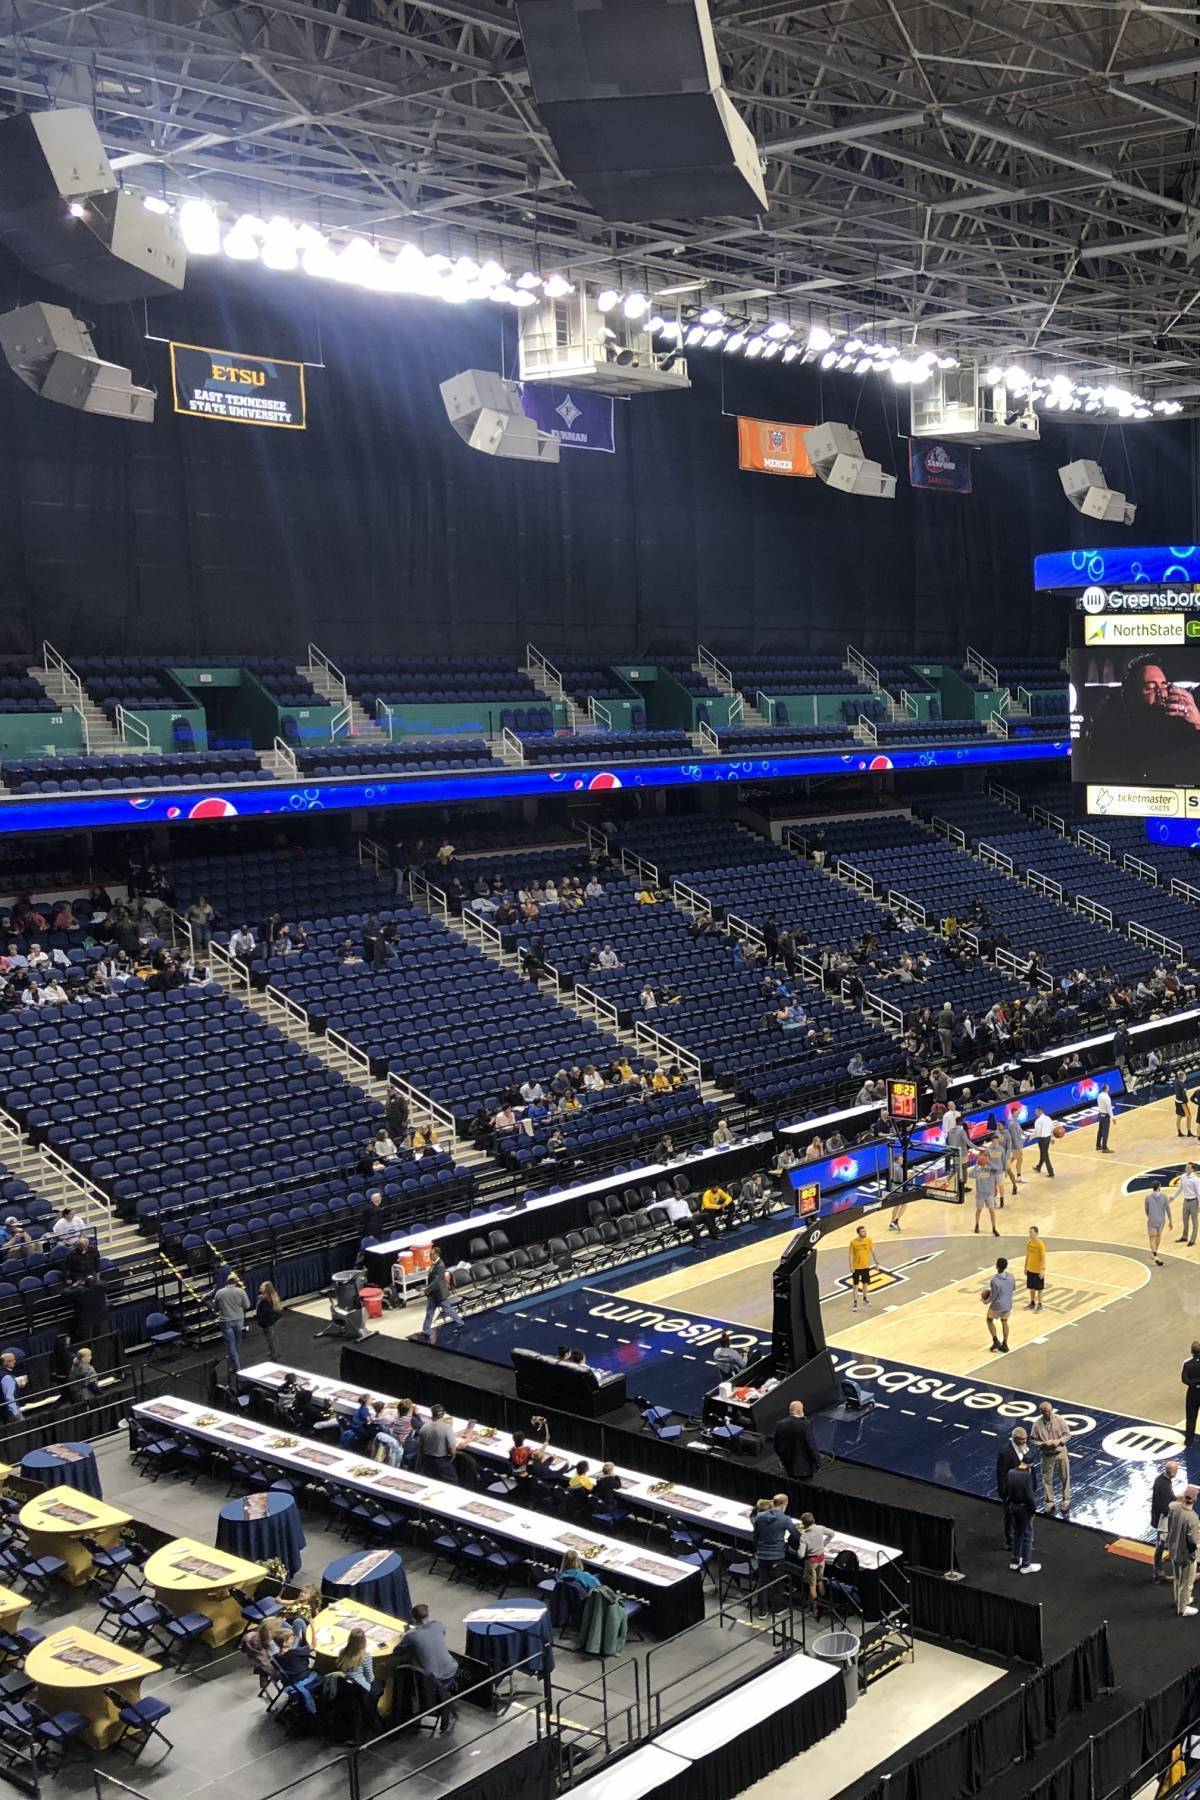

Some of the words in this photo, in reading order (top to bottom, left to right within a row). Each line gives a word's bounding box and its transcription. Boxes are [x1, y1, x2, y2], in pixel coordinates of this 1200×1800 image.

[211, 364, 265, 386] ETSU
[189, 399, 227, 415] STATE
[228, 406, 292, 423] UNIVERSITY
[193, 389, 223, 403] EAST
[224, 393, 287, 412] TENNESSEE
[1113, 623, 1183, 638] NorthState
[1118, 793, 1172, 806] ticketmaster
[894, 1083, 915, 1096] 18:23
[895, 1095, 913, 1116] 30
